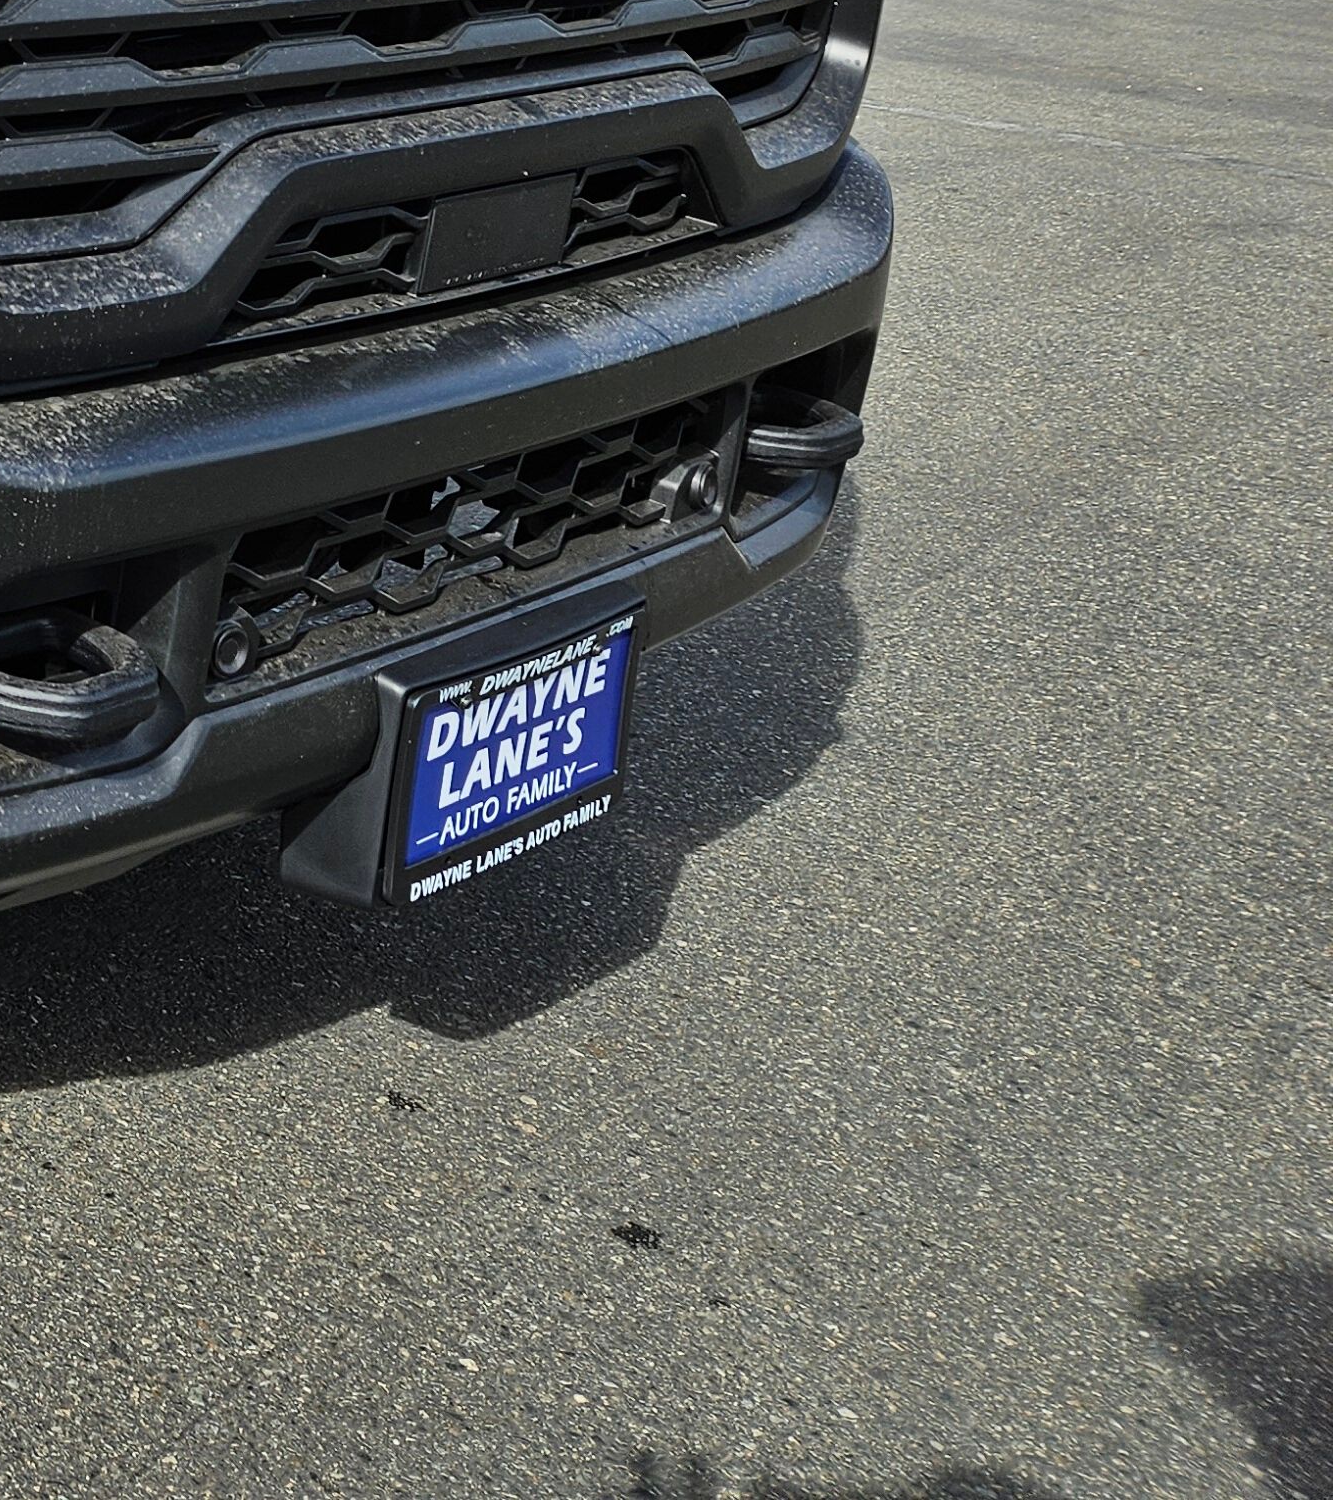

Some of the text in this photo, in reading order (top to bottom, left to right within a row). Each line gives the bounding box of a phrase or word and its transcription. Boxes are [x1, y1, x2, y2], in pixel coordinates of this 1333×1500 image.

[426, 649, 611, 762] DWAYNE
[438, 707, 586, 809] LANE'S
[409, 794, 612, 902] DWAYNE LANE'S AUTO FAMILY
[439, 762, 578, 845] AUTO FAMILY
